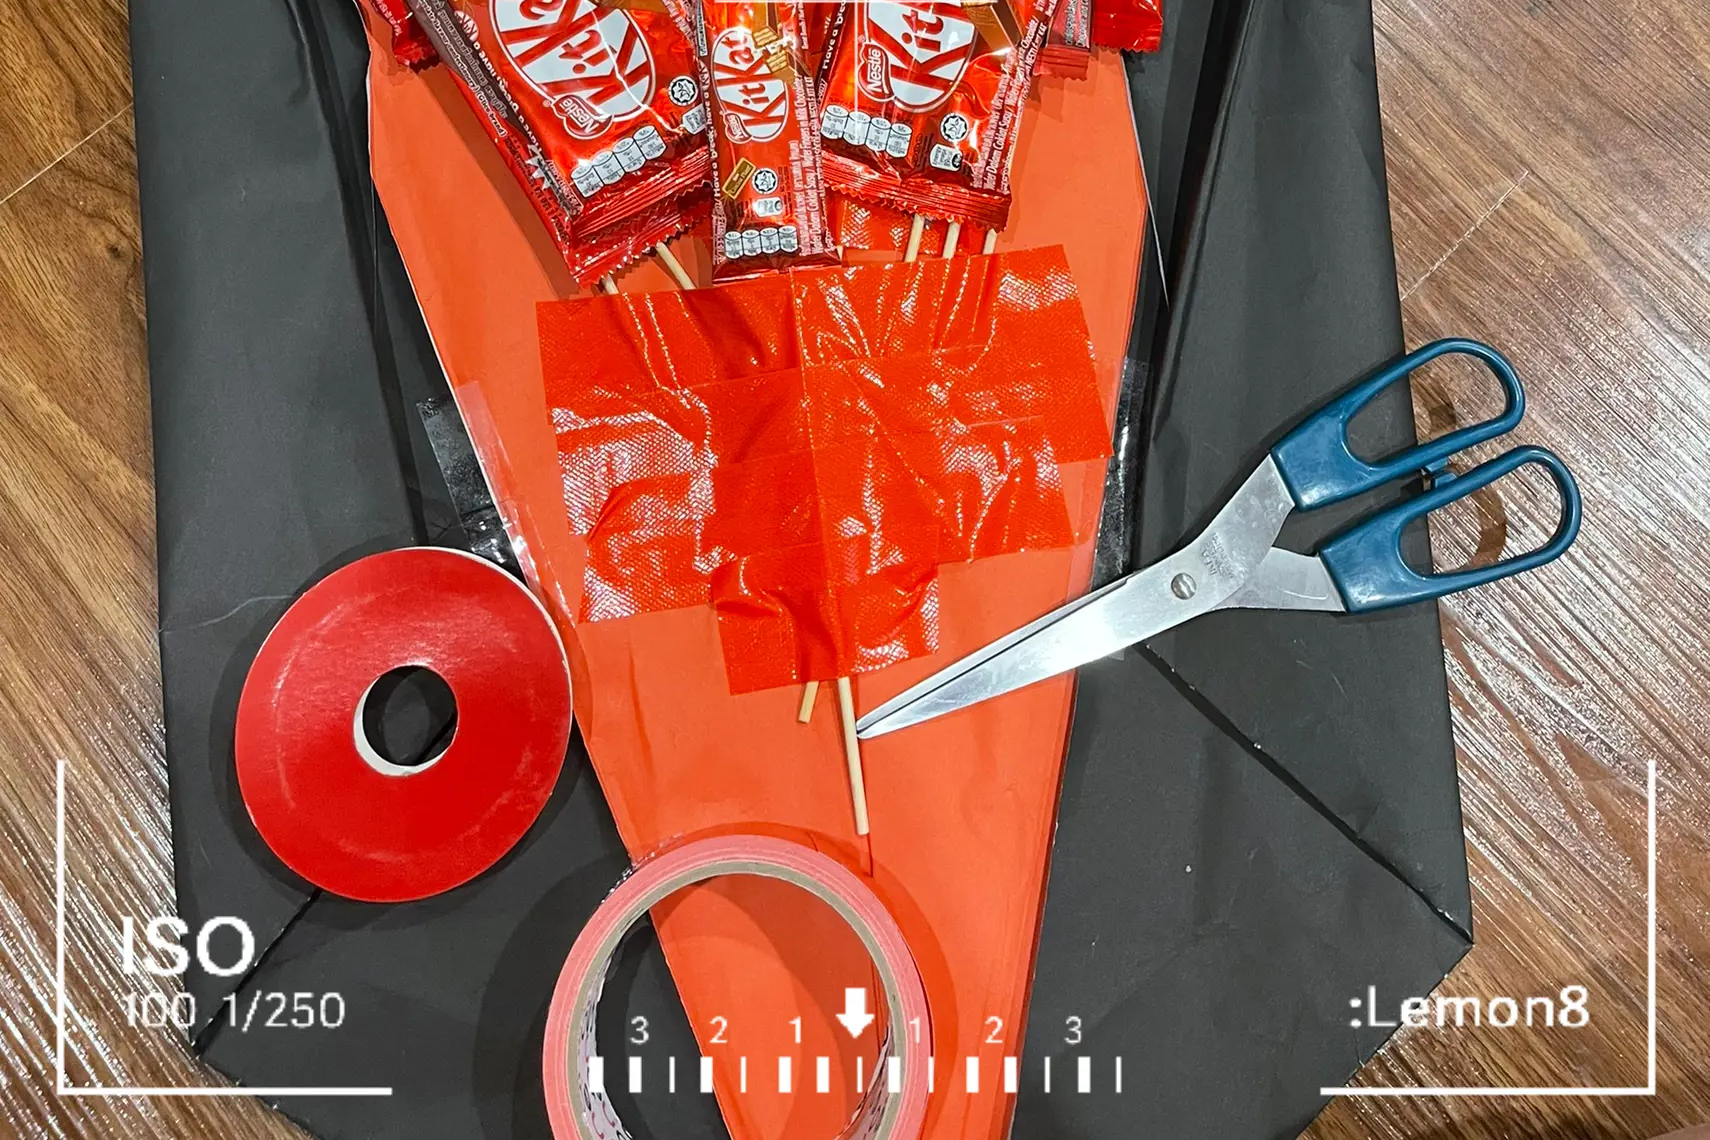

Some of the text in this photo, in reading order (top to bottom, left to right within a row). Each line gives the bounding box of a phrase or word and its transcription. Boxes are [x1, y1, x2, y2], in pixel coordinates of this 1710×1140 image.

[714, 30, 790, 136] KitKat
[704, 101, 712, 124] have
[711, 161, 717, 169] a
[711, 170, 720, 196] Have
